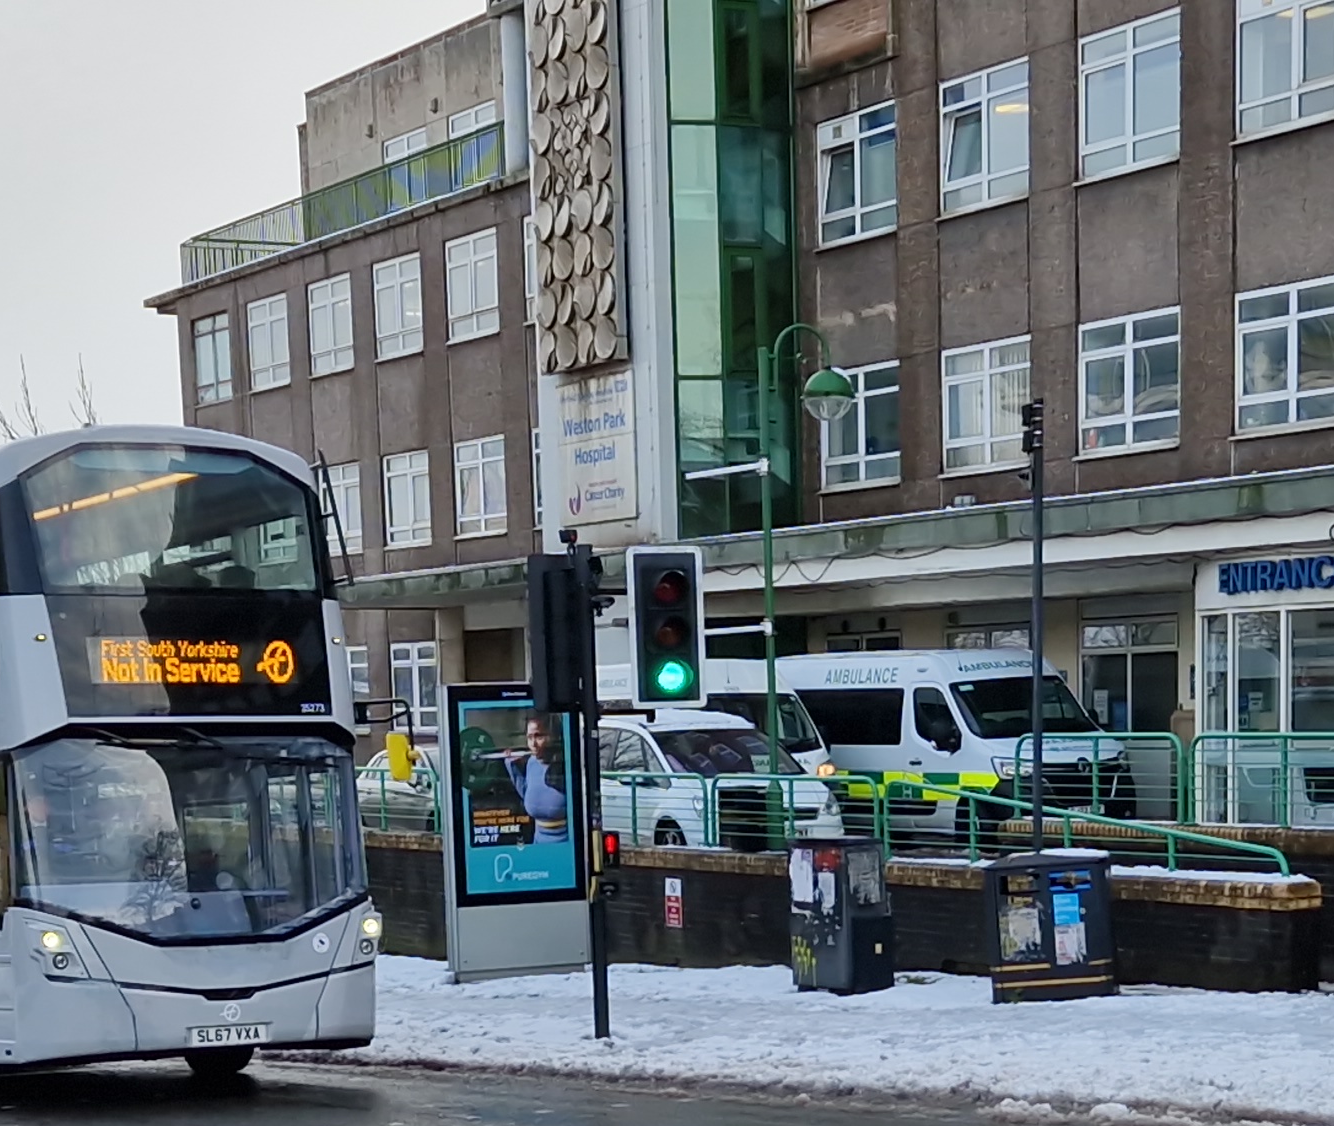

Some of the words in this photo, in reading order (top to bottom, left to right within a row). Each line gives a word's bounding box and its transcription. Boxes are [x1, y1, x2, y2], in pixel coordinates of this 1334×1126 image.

[563, 416, 601, 438] Weston
[603, 409, 626, 431] Park
[574, 440, 616, 467] Hospital
[101, 640, 134, 657] First
[138, 640, 175, 657] South
[177, 640, 239, 657] Yorkshire
[101, 658, 140, 682] Not
[144, 658, 163, 682] In
[165, 658, 241, 683] Service
[964, 660, 1033, 673] AMBULANC
[824, 667, 899, 685] AMBULANCE
[197, 1028, 232, 1042] SL67
[236, 1026, 260, 1040] VXA
